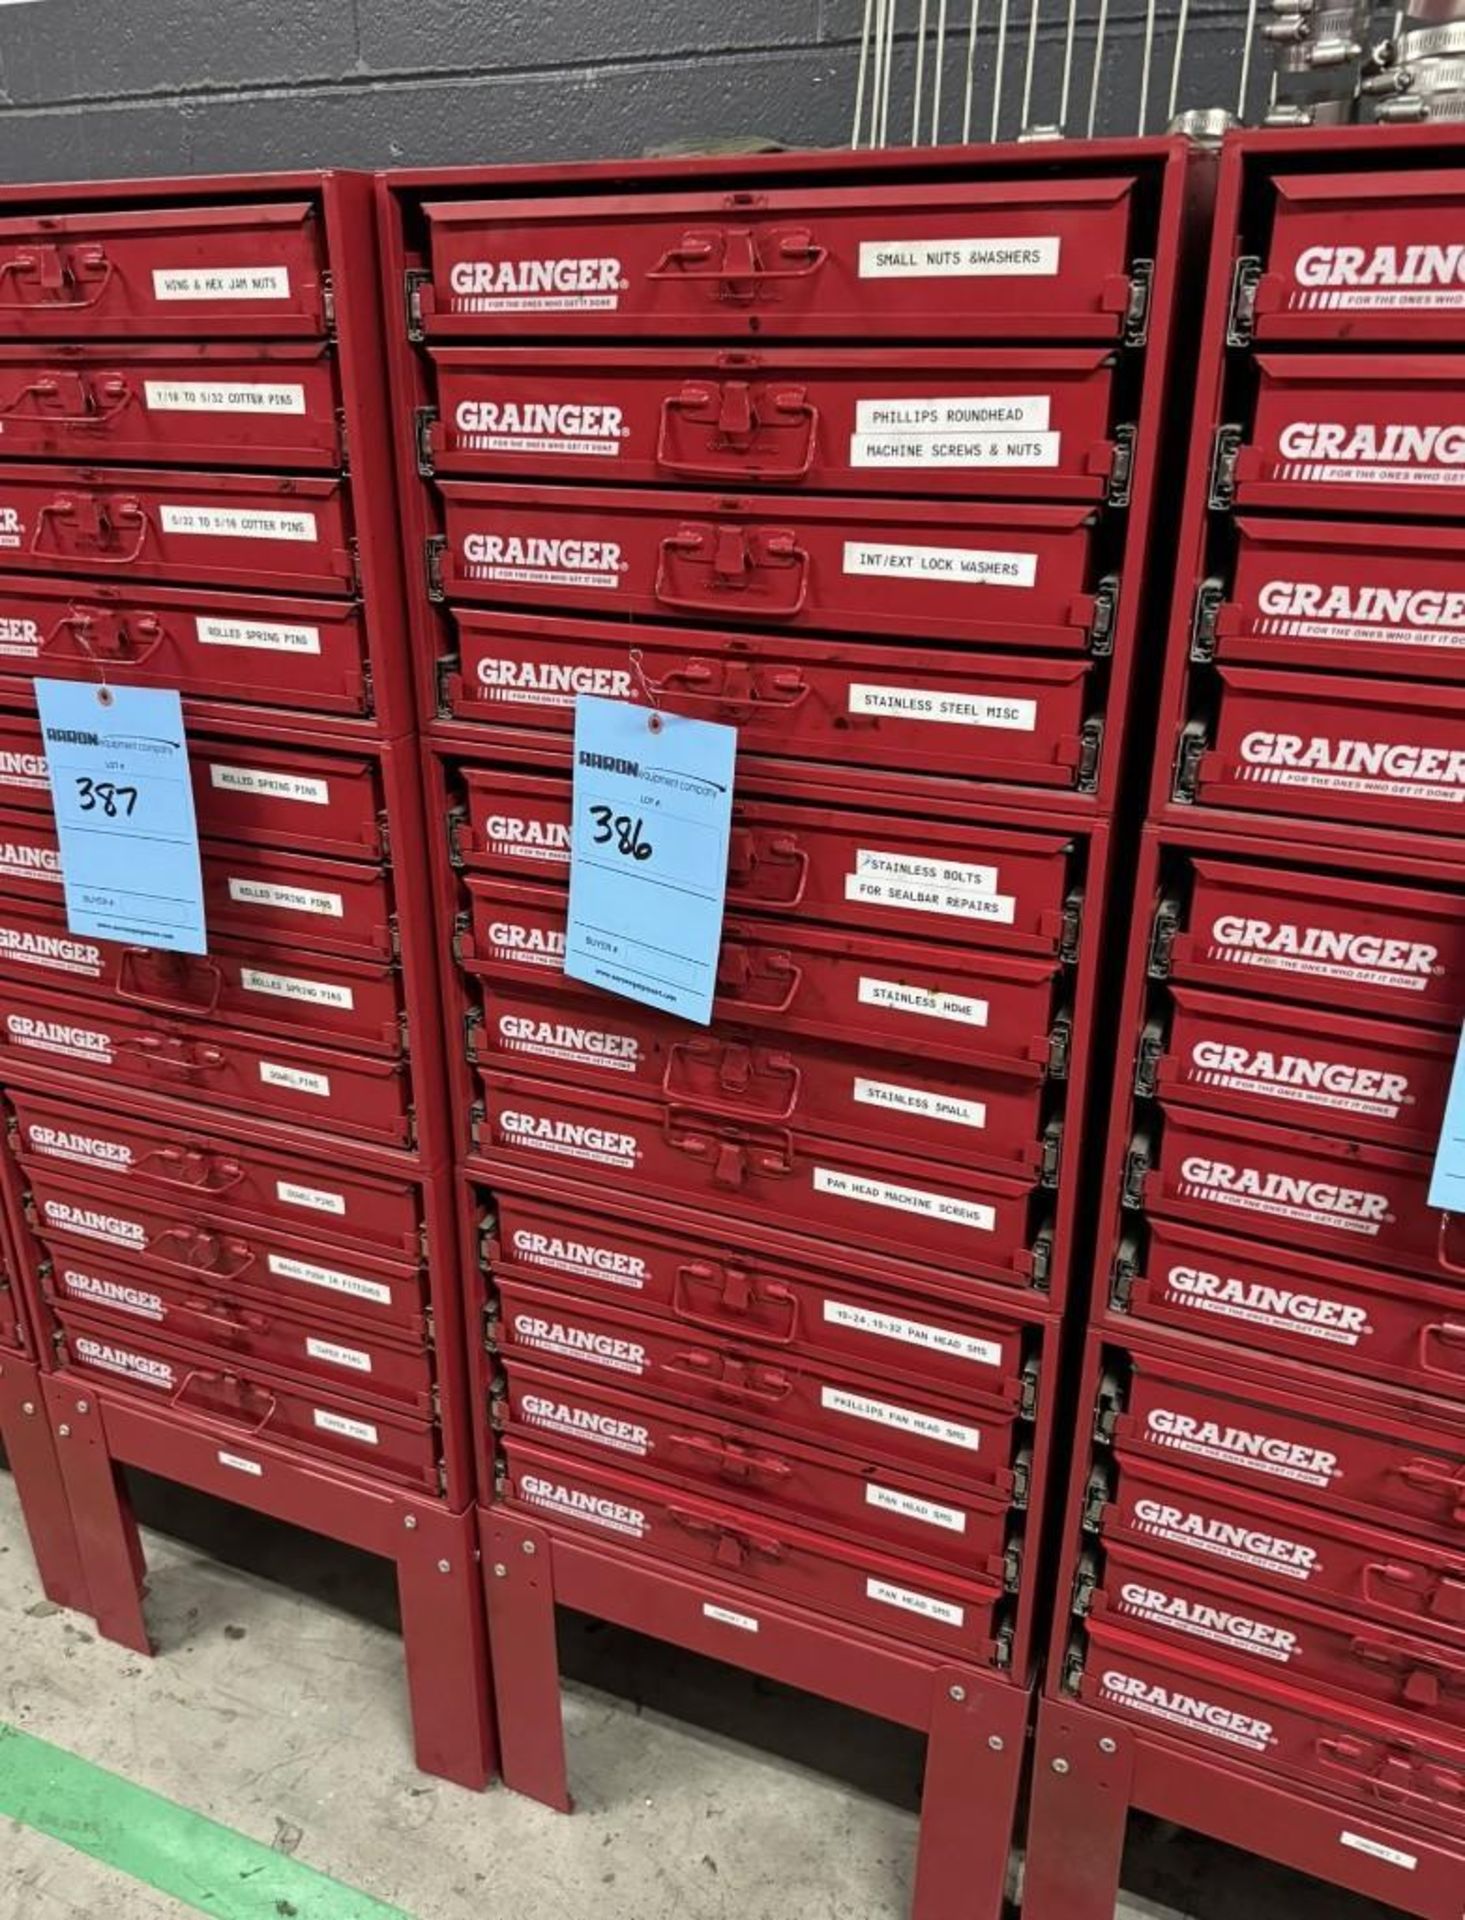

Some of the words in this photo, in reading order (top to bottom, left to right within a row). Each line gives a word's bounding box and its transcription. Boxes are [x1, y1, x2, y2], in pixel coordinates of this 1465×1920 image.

[451, 258, 620, 292] GRAINGER
[875, 253, 917, 266] SMALL
[926, 252, 960, 265] NUTS
[969, 250, 1041, 264] &WASHERS
[1295, 246, 1465, 286] GRAIN
[164, 279, 189, 290] WING
[205, 278, 223, 289] HEX
[228, 278, 247, 288] JAM
[252, 277, 276, 288] NUTS
[1346, 295, 1371, 305] FOR
[1373, 295, 1396, 304] THE
[1398, 295, 1431, 304] ONES
[1434, 294, 1463, 304] WHO
[184, 391, 195, 402] TO
[227, 392, 263, 404] COTTER
[268, 394, 292, 405] PINS
[457, 402, 622, 436] GRAINGER
[872, 410, 938, 423] PHILLIPS
[946, 408, 1023, 422] ROUNDHEAD
[866, 444, 922, 456] MACHINE
[931, 443, 981, 456] SCREWS
[988, 443, 997, 456] &
[1007, 443, 1042, 455] NUTS
[1328, 470, 1352, 479] FOR
[1354, 470, 1375, 479] THE
[1377, 471, 1410, 480] ONES
[1413, 471, 1440, 481] WHO
[1442, 472, 1464, 482] GET
[198, 516, 210, 526] TO
[241, 518, 275, 530] COTTER
[280, 521, 304, 532] PINS
[464, 534, 620, 570] GRAINGER
[860, 553, 913, 568] INT/EXT
[921, 557, 953, 571] LOCK
[960, 560, 1018, 575] WASHERS
[207, 626, 240, 638] ROLLED
[246, 630, 279, 642] SPRING
[283, 633, 307, 645] PINS
[1305, 626, 1328, 636] FOR
[1330, 628, 1350, 637] THE
[1352, 629, 1383, 640] ONES
[1385, 631, 1411, 641] WHO
[1414, 633, 1435, 643] GET
[478, 658, 631, 696] GRAINGER
[864, 694, 931, 711] STAINLESS
[939, 701, 978, 716] STEEL
[986, 706, 1019, 720] MISC
[47, 728, 98, 746] AARON
[579, 751, 638, 778] AARON
[76, 777, 137, 817] 387
[221, 773, 253, 786] ROLLED
[257, 778, 290, 792] SPRING
[294, 784, 317, 796] PINS
[640, 795, 654, 804] LOT
[1286, 774, 1308, 783] FOR
[1309, 777, 1329, 785] THE
[1332, 779, 1359, 788] ONES
[1363, 782, 1388, 791] WHO
[1390, 784, 1411, 794] GET
[1425, 788, 1456, 798] DONE
[590, 806, 652, 860] 386
[0, 843, 60, 870] AING
[871, 859, 936, 878] STAINLESS
[943, 869, 981, 884] BOLTS
[239, 886, 270, 899] ROLLED
[274, 891, 306, 905] SPRING
[310, 897, 331, 909] PINS
[859, 883, 880, 896] FOR
[888, 887, 938, 904] SEALBAR
[946, 896, 999, 914] REPAIRS
[0, 928, 99, 965] GRAINGER
[585, 936, 611, 952] BUYER
[1213, 916, 1438, 973] GRAINGER
[285, 983, 317, 997] SPRING
[321, 989, 341, 1002] PINS
[872, 987, 935, 1009] STAINLESS
[7, 1015, 111, 1053] GRAINGER
[499, 1015, 638, 1060] GRAINGER
[1193, 1041, 1408, 1103] GRAINGER
[867, 1087, 928, 1109] STAINLESS
[935, 1101, 970, 1118] SMALL
[29, 1125, 132, 1164] GRAINGER
[500, 1111, 636, 1156] GRAINGER
[827, 1177, 845, 1189] PAN
[851, 1183, 878, 1197] HEAD
[884, 1190, 931, 1210] MACHINE
[938, 1203, 980, 1221] SCREWS
[1181, 1158, 1389, 1219] GRAINGER
[44, 1200, 145, 1241] GRAINGER
[514, 1230, 645, 1278] GRAINGER
[64, 1270, 163, 1312] GRAINGER
[1168, 1266, 1367, 1331] GRAINGER
[514, 1315, 645, 1364] GRAINGER
[908, 1327, 927, 1341] PAN
[933, 1334, 961, 1350] HEAD
[967, 1343, 987, 1356] SMS
[76, 1338, 172, 1379] GRAINGER
[522, 1395, 649, 1444] GRAINGER
[833, 1395, 883, 1417] PHILLIPS
[889, 1411, 908, 1424] PAN
[913, 1418, 939, 1433] HEAD
[945, 1427, 965, 1441] SMS
[1148, 1409, 1337, 1475] GRAINGER
[521, 1476, 645, 1527] GRAINGER
[878, 1493, 896, 1506] PAN
[902, 1500, 927, 1516] HEAD
[933, 1510, 952, 1523] SMS
[1135, 1500, 1317, 1570] GRAINGER
[878, 1588, 896, 1600] PAN
[902, 1595, 926, 1610] HEAD
[1121, 1584, 1296, 1651] GRAINGER
[1103, 1671, 1272, 1741] GRAINGER
